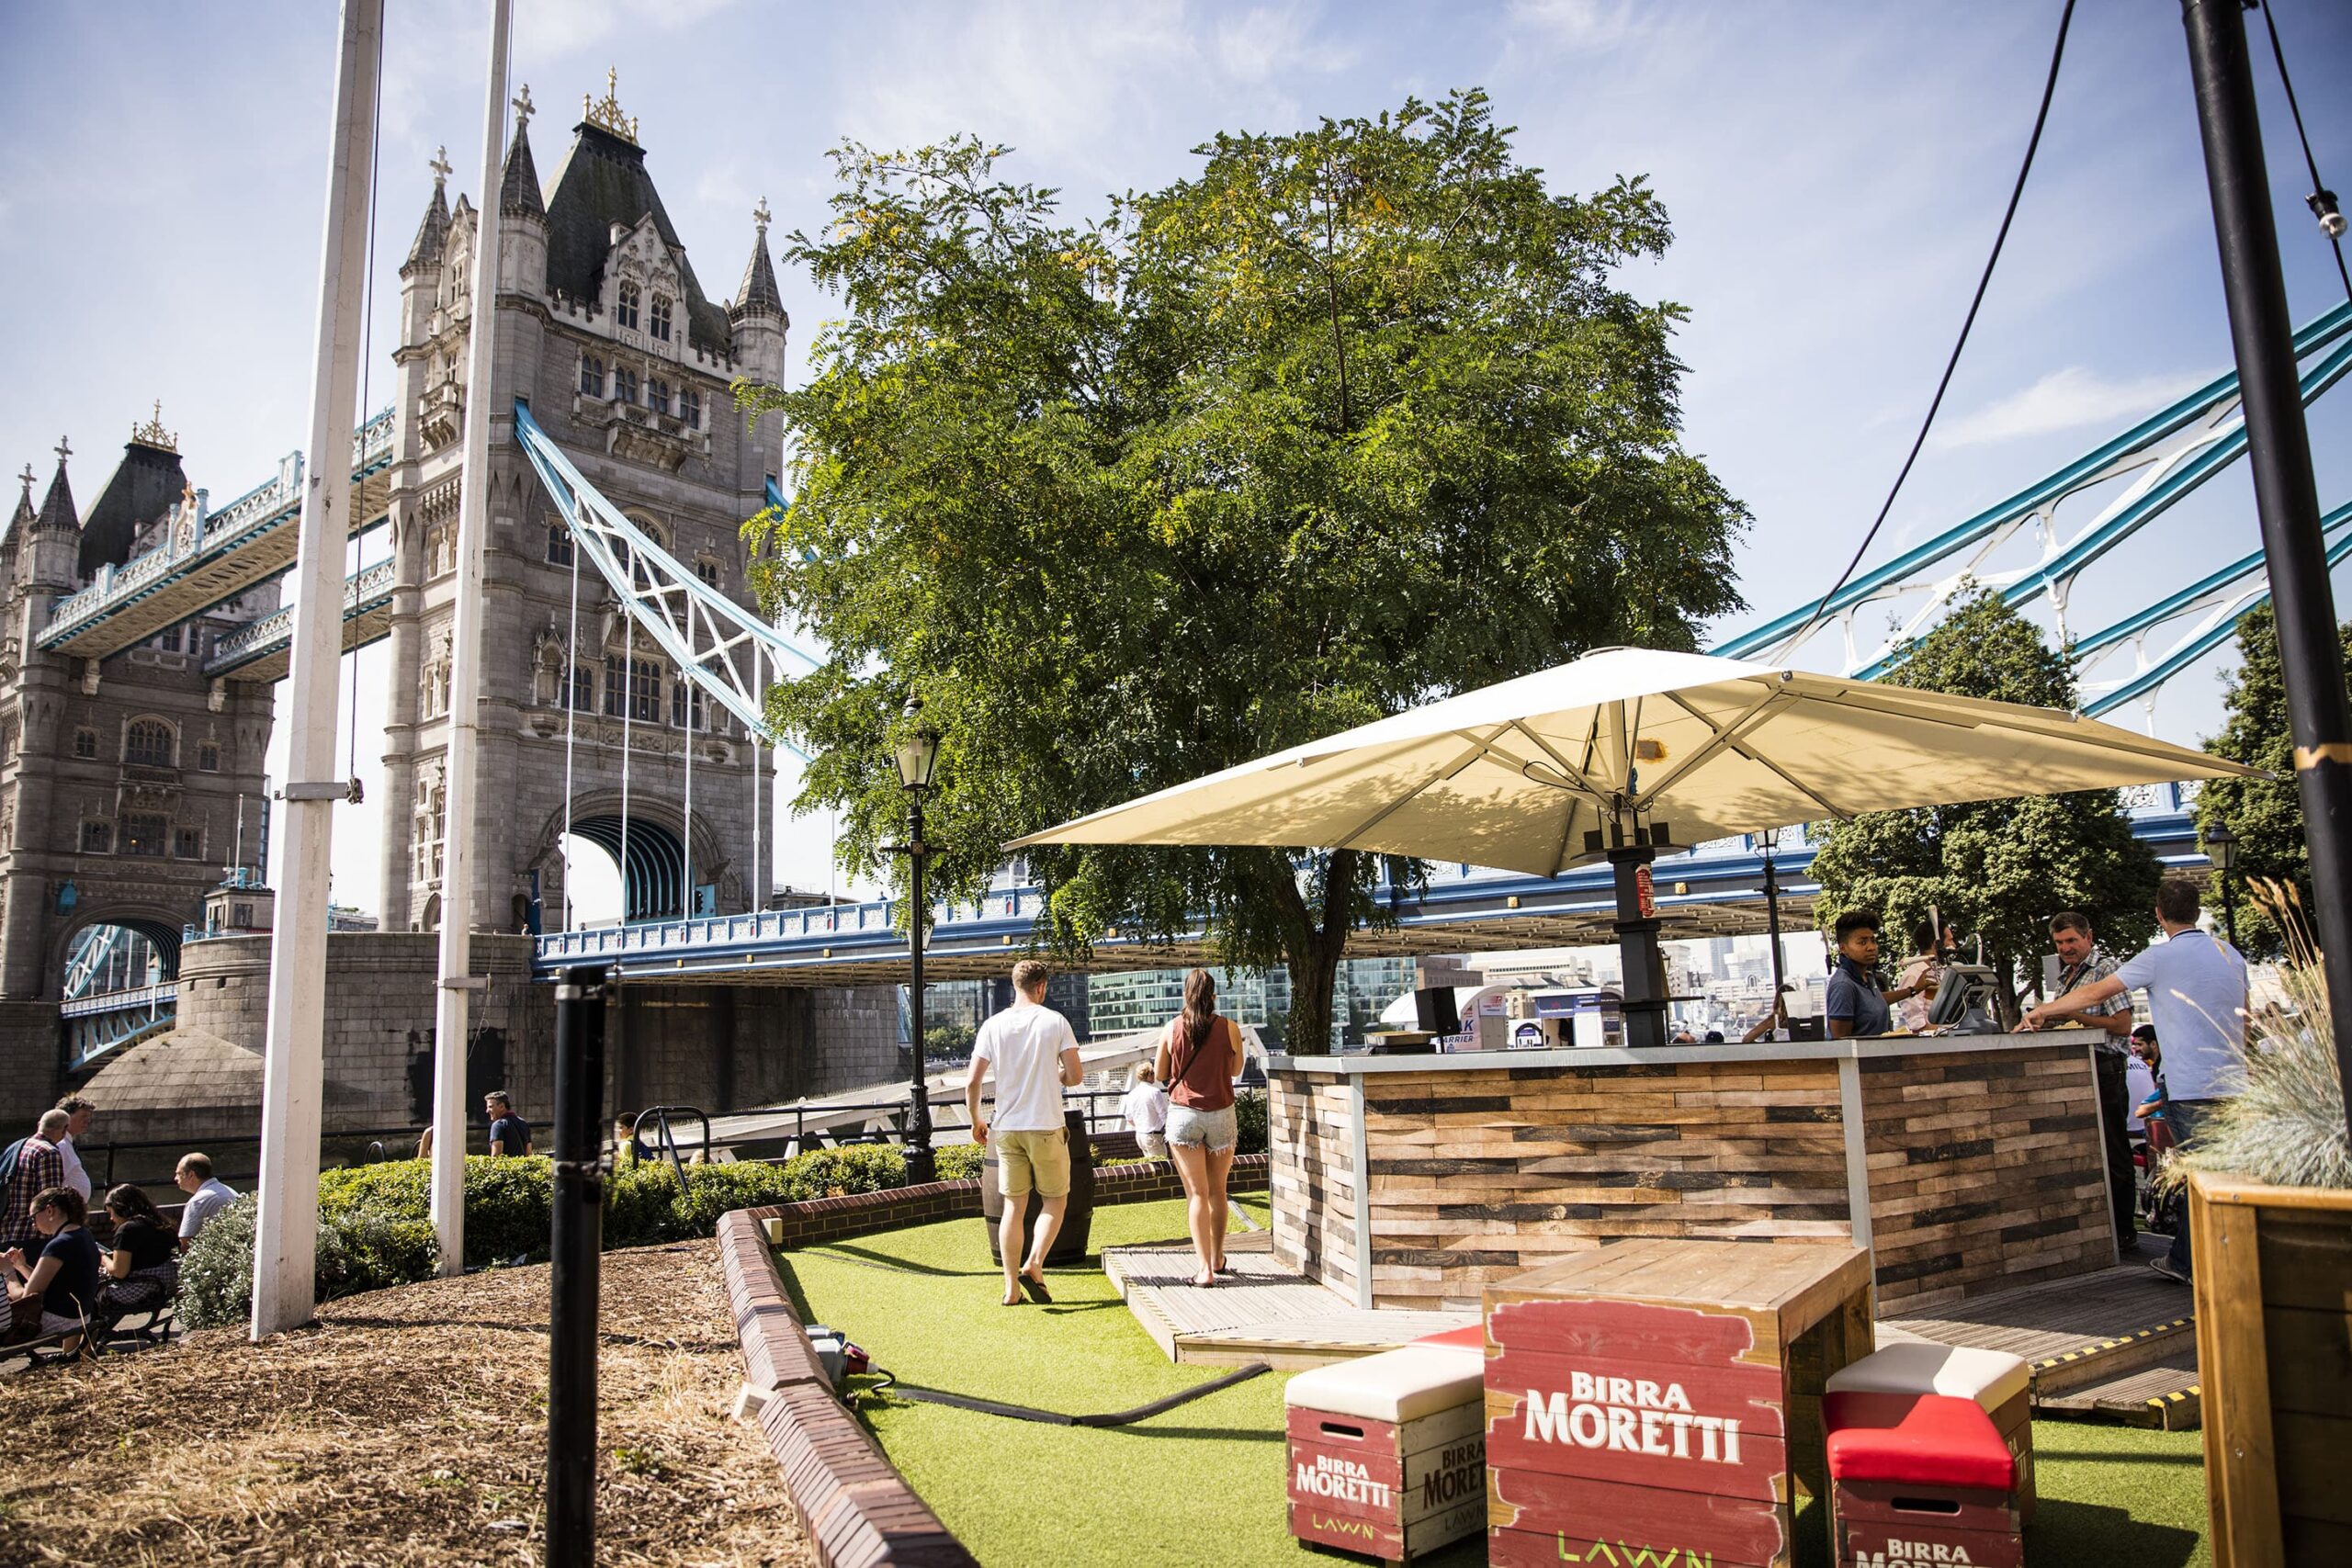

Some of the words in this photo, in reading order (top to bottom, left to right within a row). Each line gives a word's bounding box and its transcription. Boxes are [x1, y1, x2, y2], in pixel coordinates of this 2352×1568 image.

[1437, 1034, 1474, 1044] ARRIER
[1569, 1371, 1696, 1413] BIRRA
[1522, 1389, 1744, 1465] MORETTI
[1317, 1454, 1371, 1481] BIRRA
[1442, 1439, 1485, 1471] BIRRA
[1296, 1462, 1391, 1509] MORETTI
[1423, 1461, 1486, 1511] MORET
[1312, 1513, 1374, 1540] LAWN
[1557, 1529, 1713, 1568] LAWN
[1886, 1538, 1973, 1564] BIRRA
